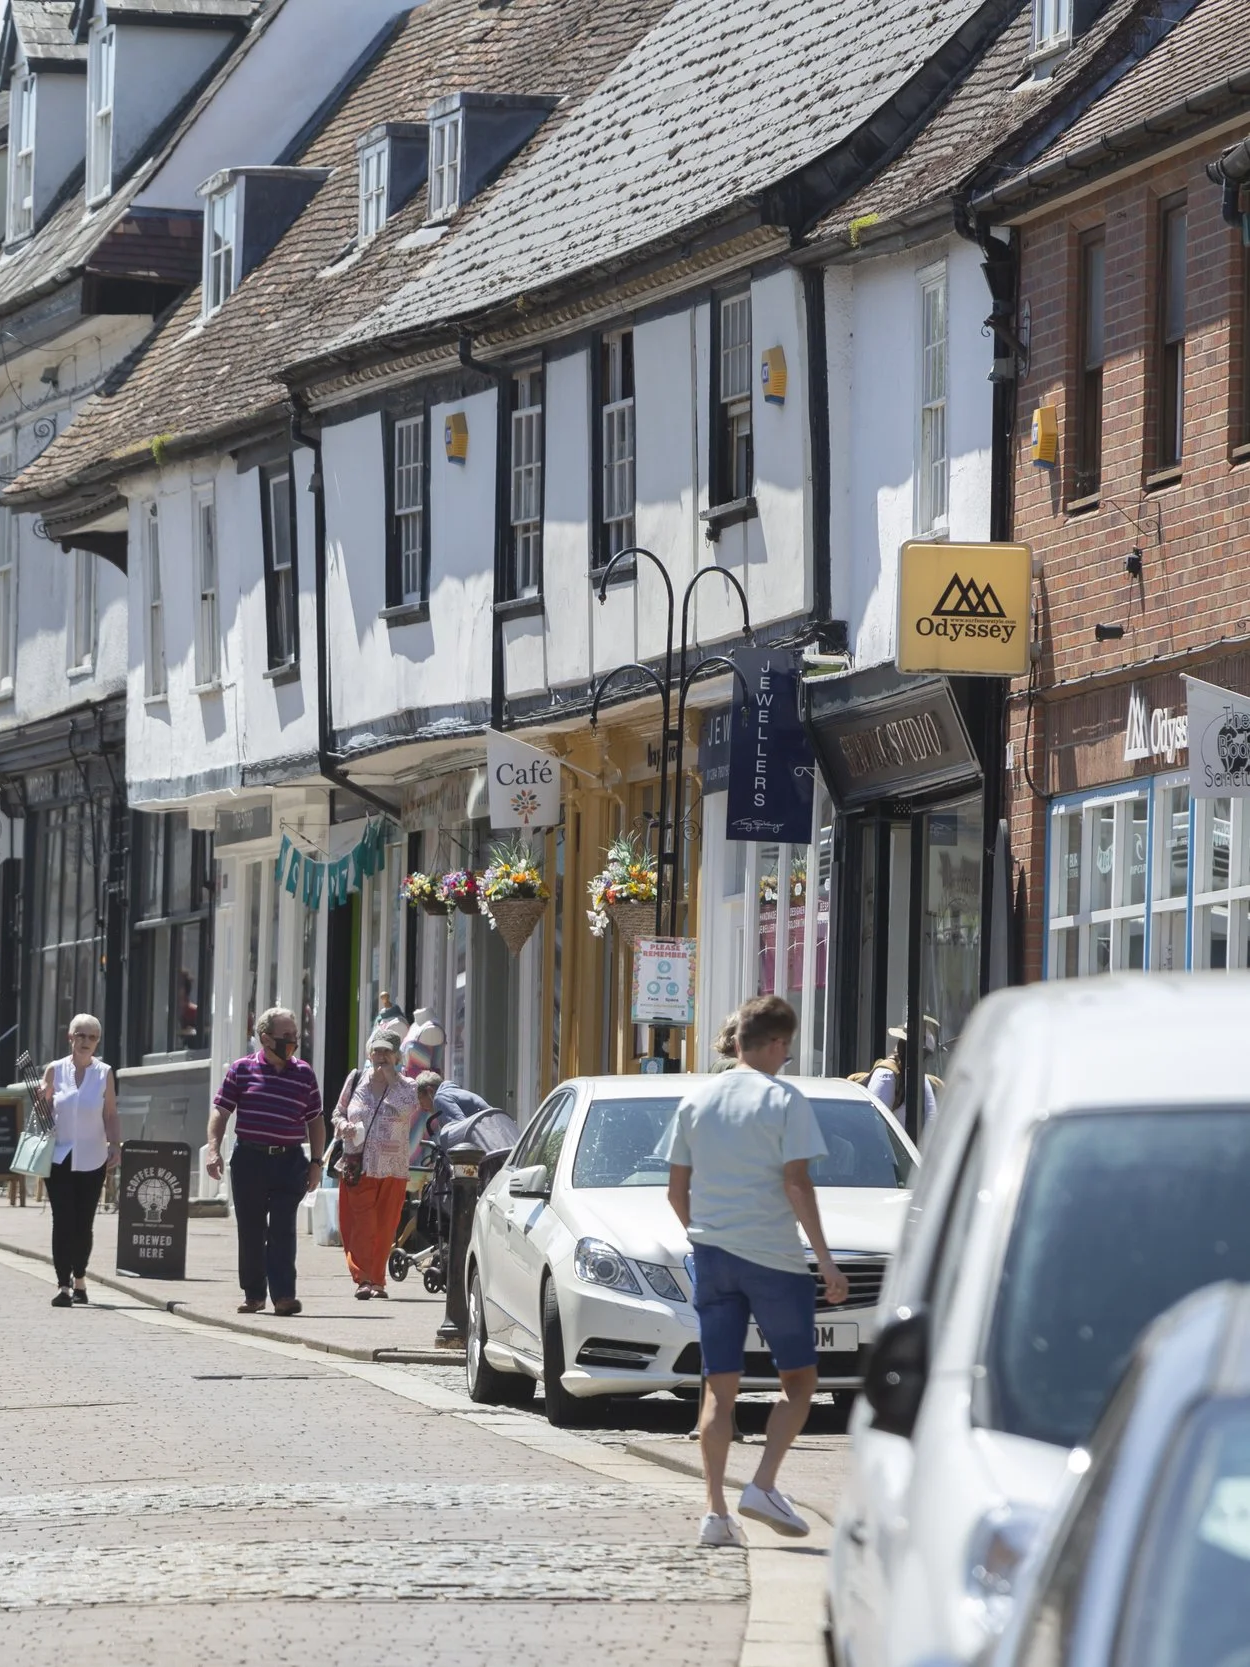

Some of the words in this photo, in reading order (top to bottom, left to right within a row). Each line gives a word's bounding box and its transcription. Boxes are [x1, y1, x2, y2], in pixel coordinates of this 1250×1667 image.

[915, 616, 1017, 643] Odyssey
[1222, 703, 1250, 729] The
[754, 660, 774, 807] JEWELLERS
[886, 712, 942, 766] STUDIO
[496, 759, 553, 787] Café
[643, 951, 687, 959] REMEMBER
[649, 944, 681, 952] PLEASE
[127, 1167, 155, 1193] COFFEE
[157, 1167, 183, 1195] WORLD
[132, 1234, 173, 1247] BREWED
[139, 1247, 165, 1259] HERE
